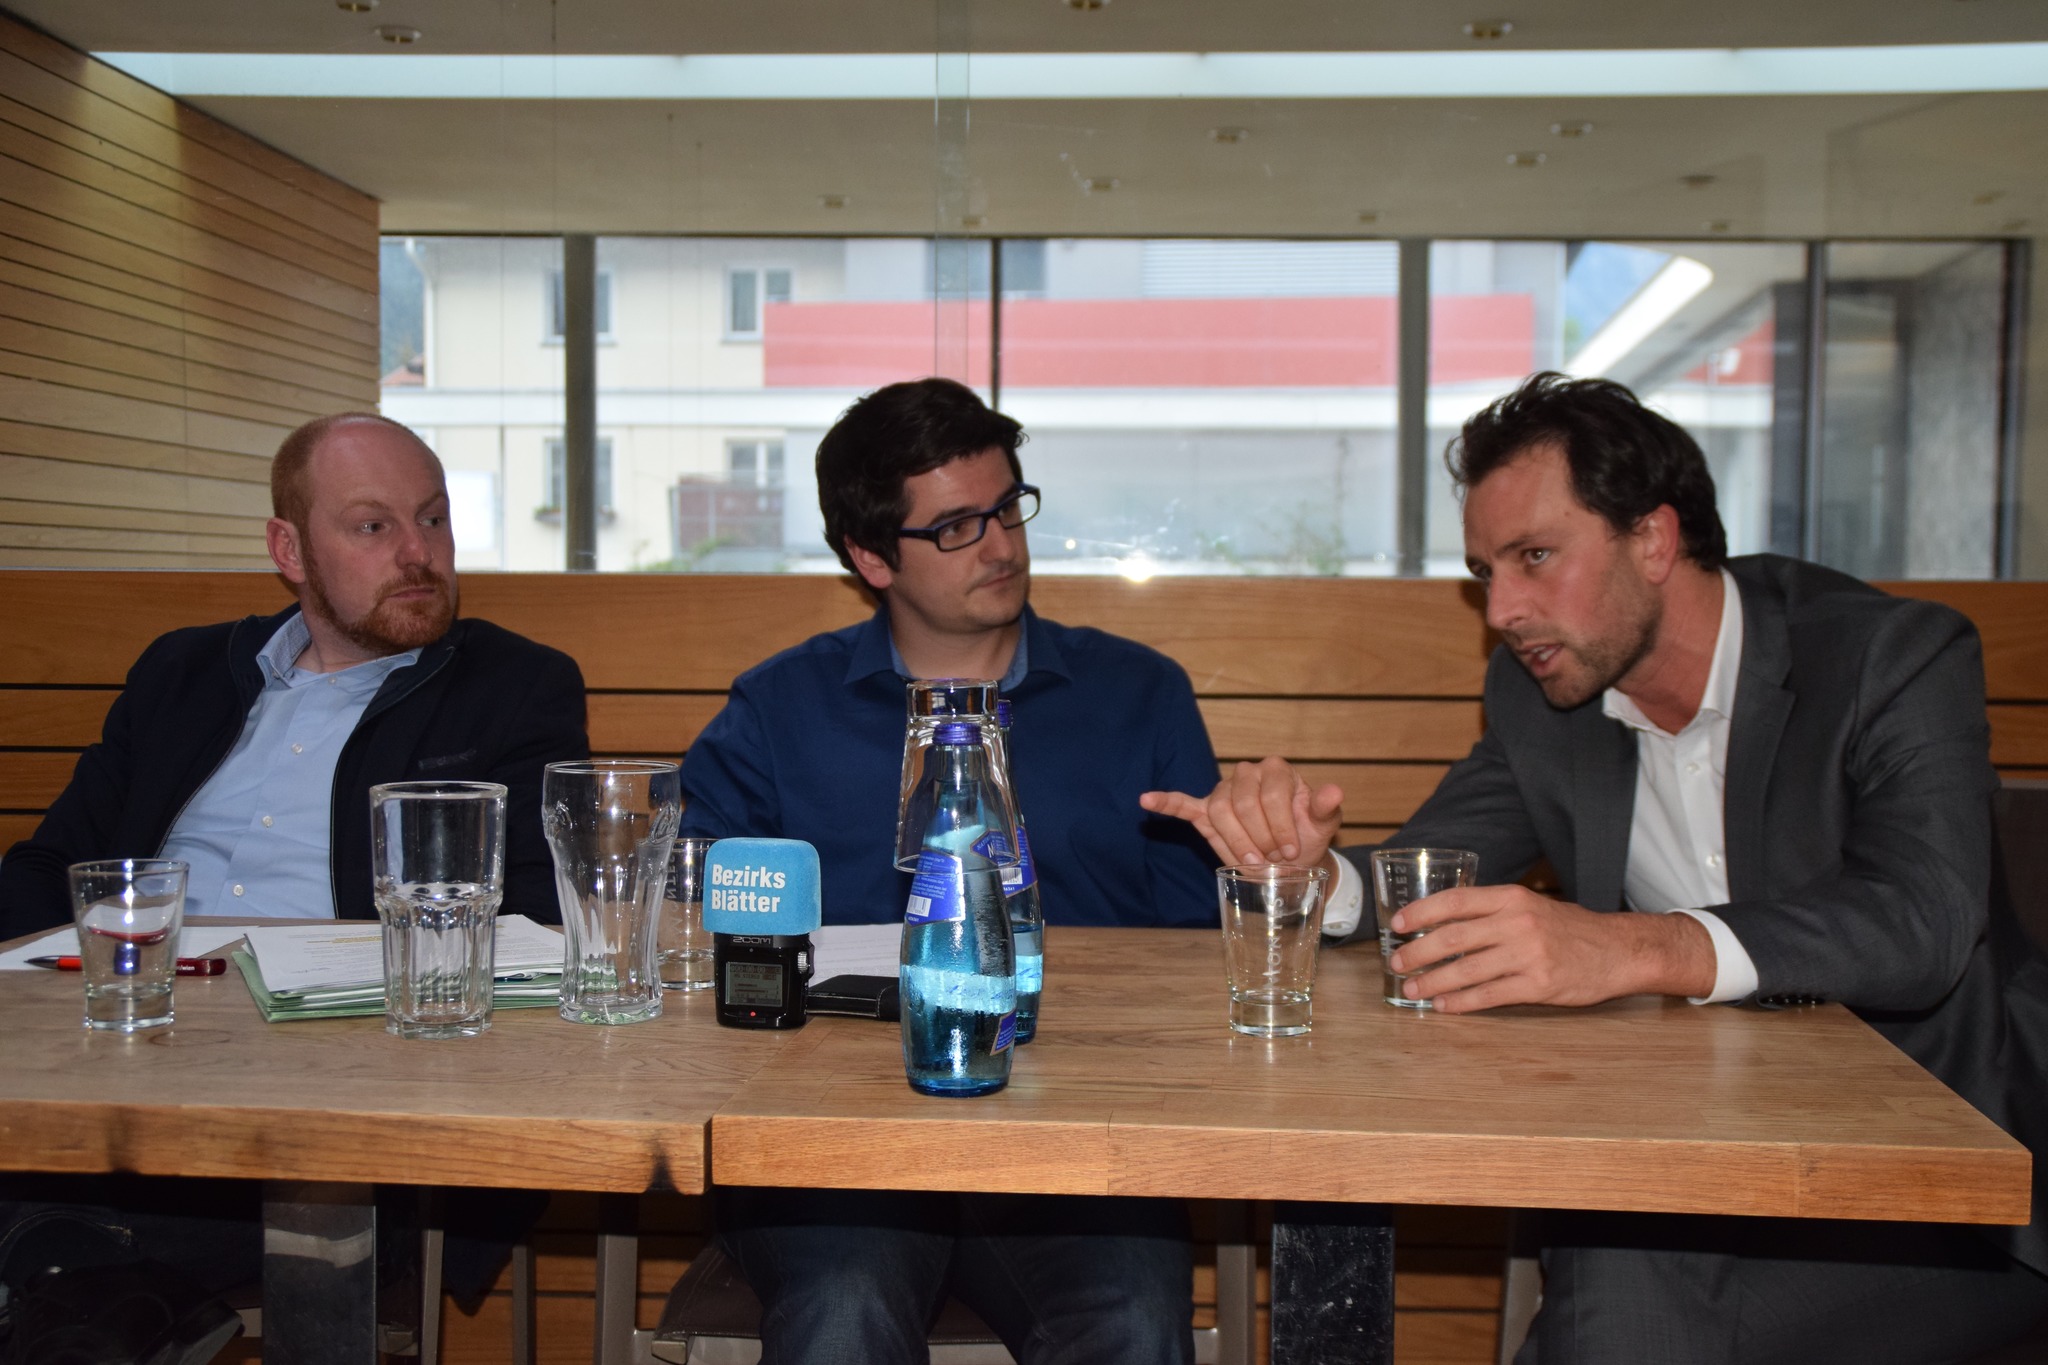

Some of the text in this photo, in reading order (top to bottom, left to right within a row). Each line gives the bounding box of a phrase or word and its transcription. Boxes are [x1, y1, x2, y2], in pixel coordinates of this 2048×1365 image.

[712, 863, 786, 889] Bezirks
[711, 889, 781, 913] Blätter
[732, 936, 771, 945] ZOOM
